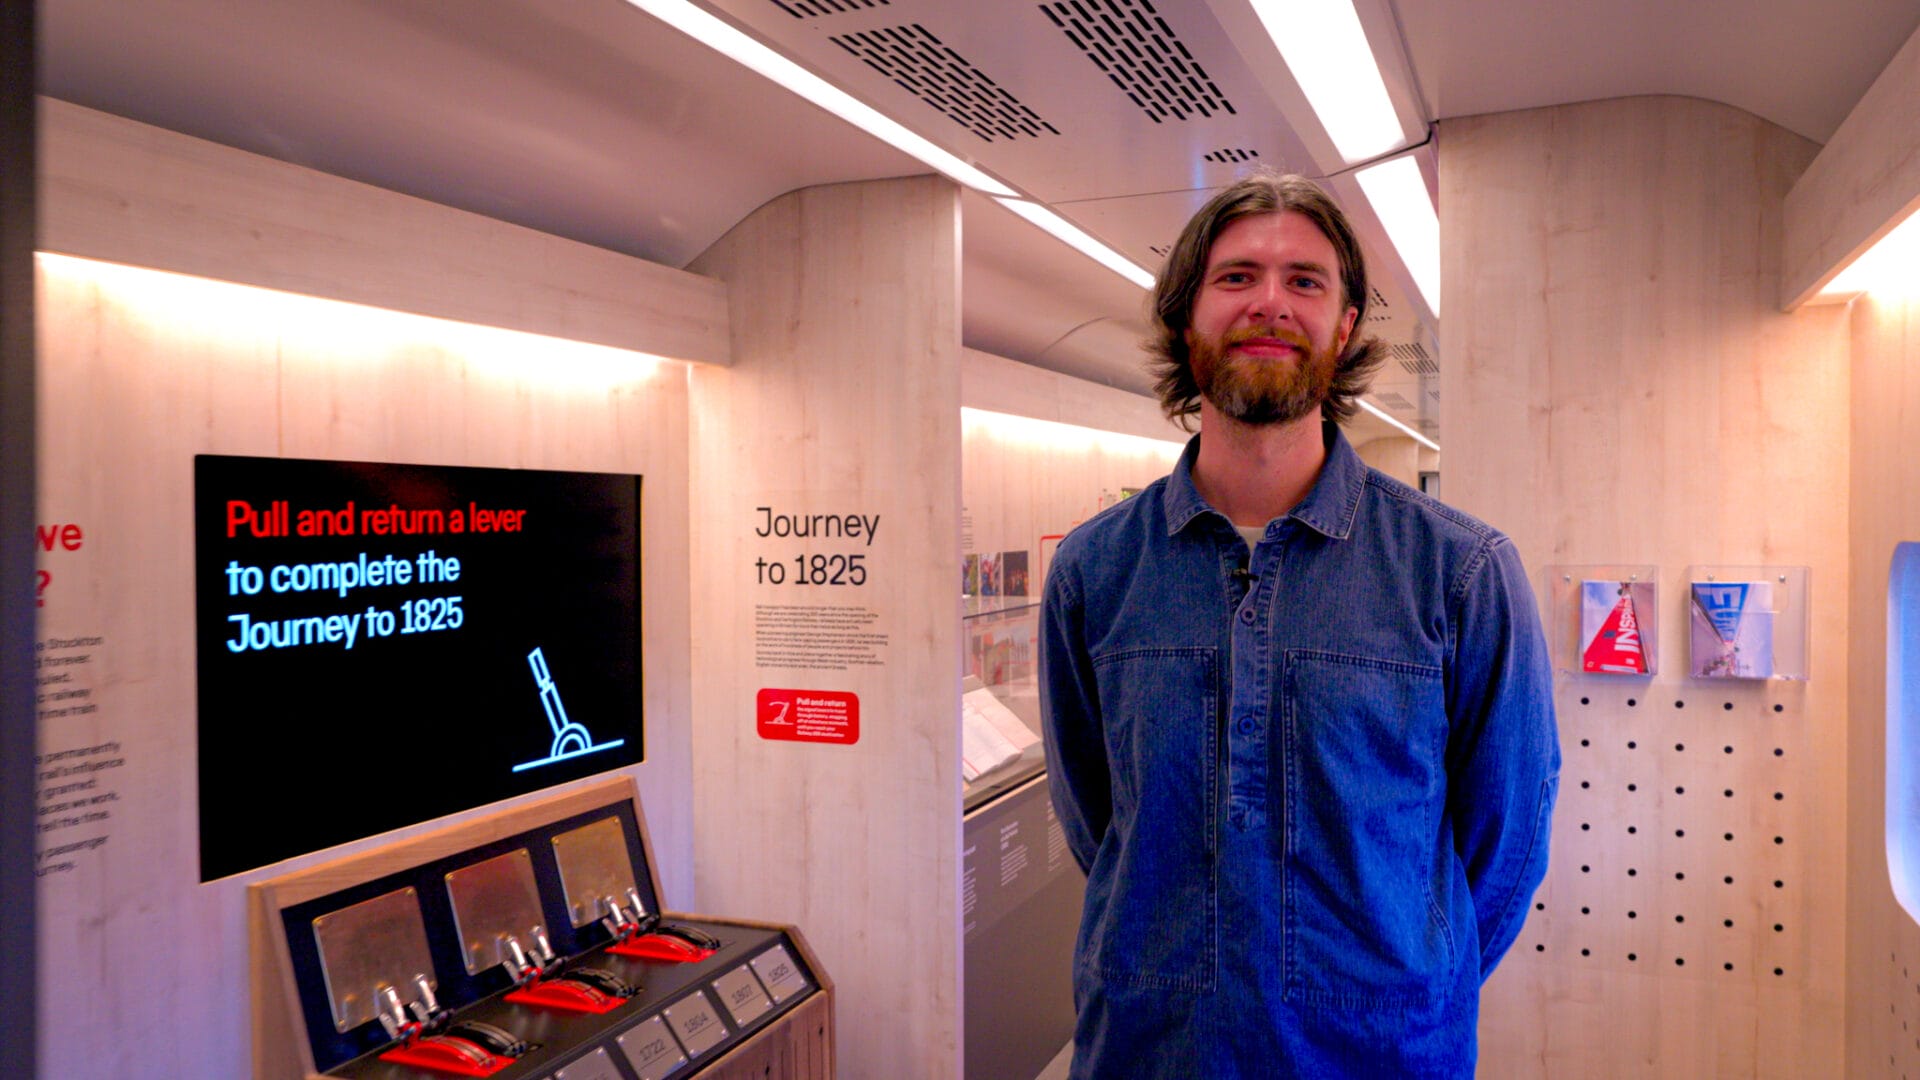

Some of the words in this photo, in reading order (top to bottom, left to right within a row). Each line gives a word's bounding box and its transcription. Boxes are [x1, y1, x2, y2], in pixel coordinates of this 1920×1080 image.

[227, 500, 289, 538] Pull
[296, 501, 355, 536] and
[361, 504, 444, 535] return
[449, 509, 464, 534] a
[469, 502, 526, 533] lever
[755, 507, 880, 546] Journey
[225, 561, 264, 596] to
[270, 552, 413, 598] complete
[416, 550, 461, 583] the
[755, 557, 785, 585] to
[794, 554, 867, 586] 1825
[226, 613, 361, 653] Journey
[364, 606, 395, 638] to
[400, 596, 464, 634] 1825
